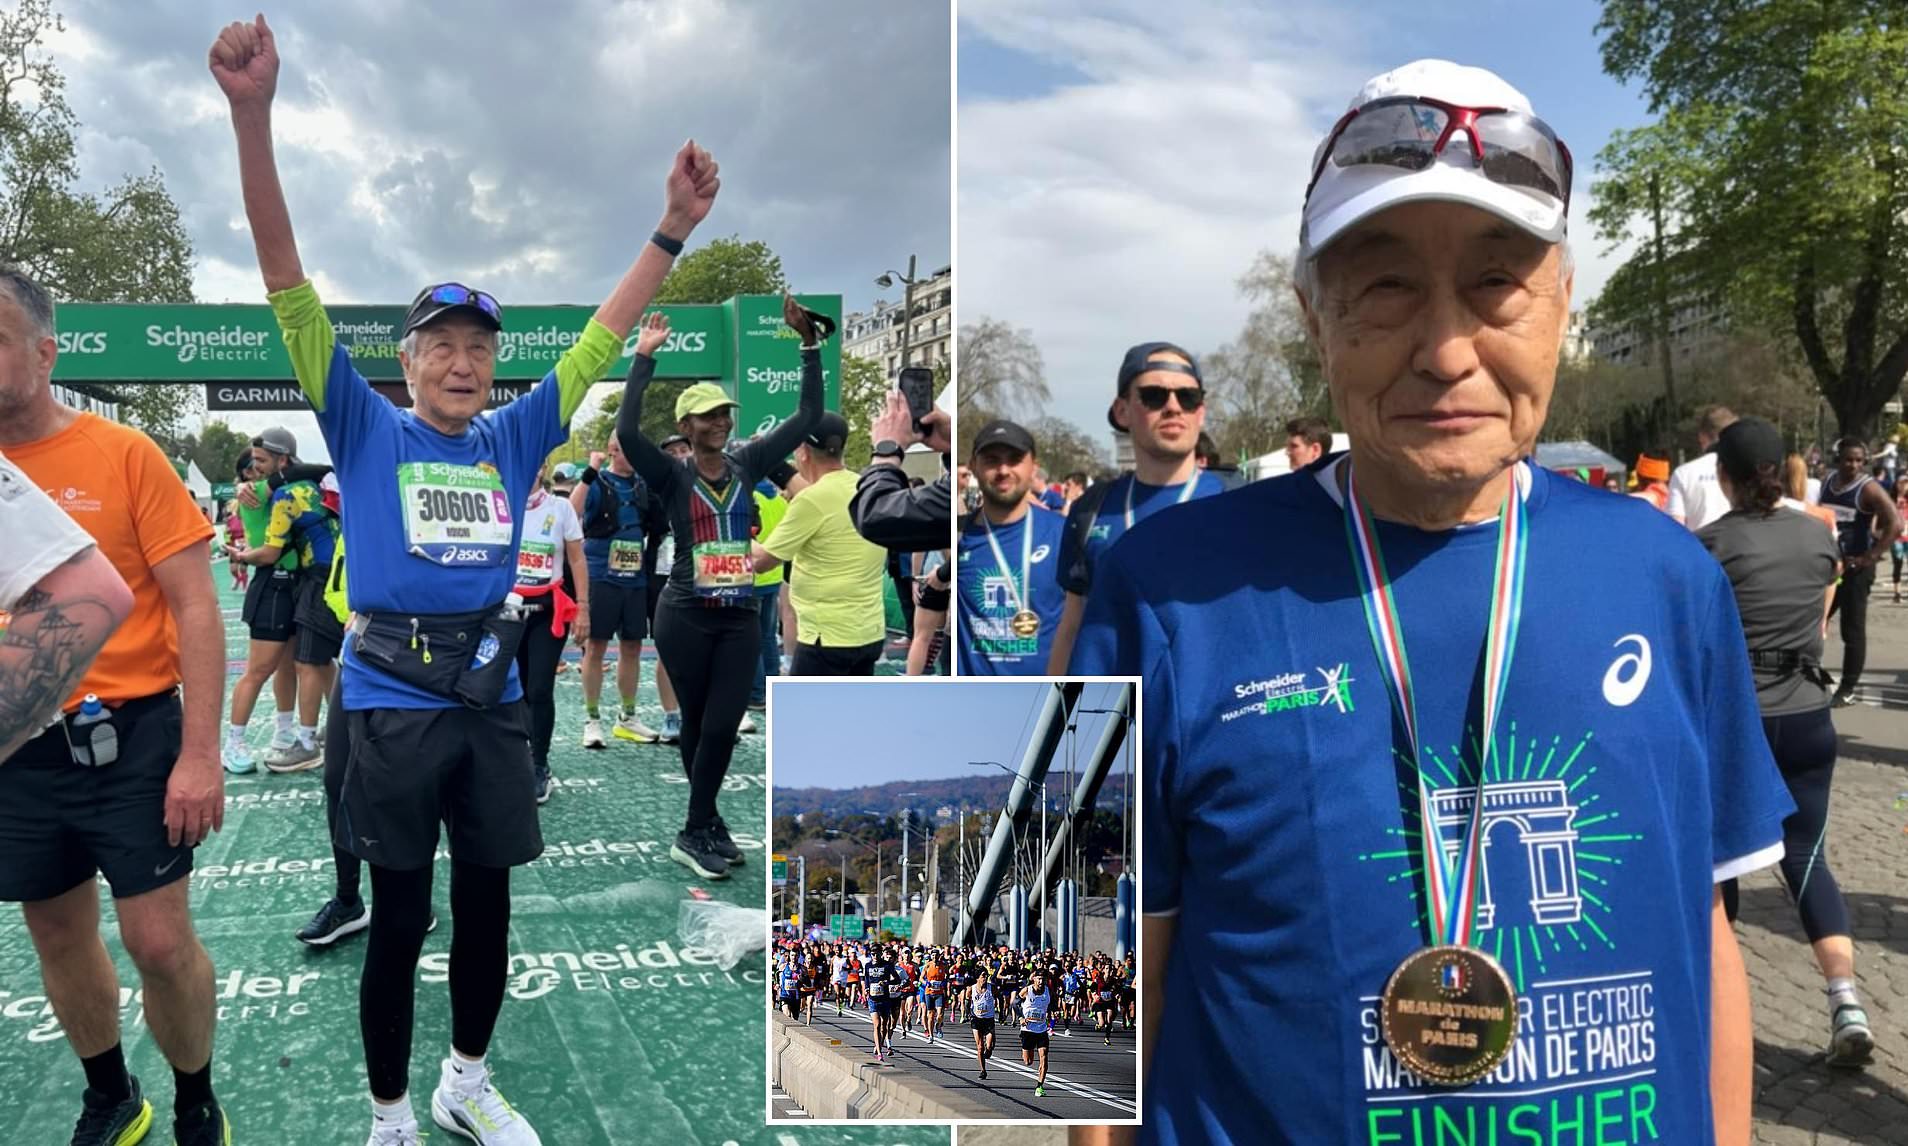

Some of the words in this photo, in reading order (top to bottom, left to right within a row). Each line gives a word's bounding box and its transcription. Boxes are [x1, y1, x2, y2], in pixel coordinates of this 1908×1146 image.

[146, 325, 269, 346] Schneider
[332, 321, 394, 334] chneider
[496, 326, 582, 346] hneider
[56, 332, 107, 353] SICS
[658, 331, 707, 352] SICS
[200, 347, 268, 361] Electric
[747, 366, 830, 383] Schneir
[218, 387, 304, 402] GARMIN
[430, 463, 491, 480] Schneider
[417, 488, 491, 523] 30606
[1234, 672, 1306, 698] Schneider
[1221, 702, 1266, 722] MARATHON
[1266, 691, 1320, 713] PARIS
[571, 970, 766, 992] Electric
[1397, 998, 1504, 1021] MARATHON
[1542, 983, 1655, 1032] ELECTRIC
[1440, 1017, 1460, 1031] de
[1421, 1029, 1478, 1049] PARIS
[1546, 1031, 1579, 1079] DE
[1586, 1020, 1656, 1071] PARIS
[1368, 1083, 1659, 1146] FINISHER
